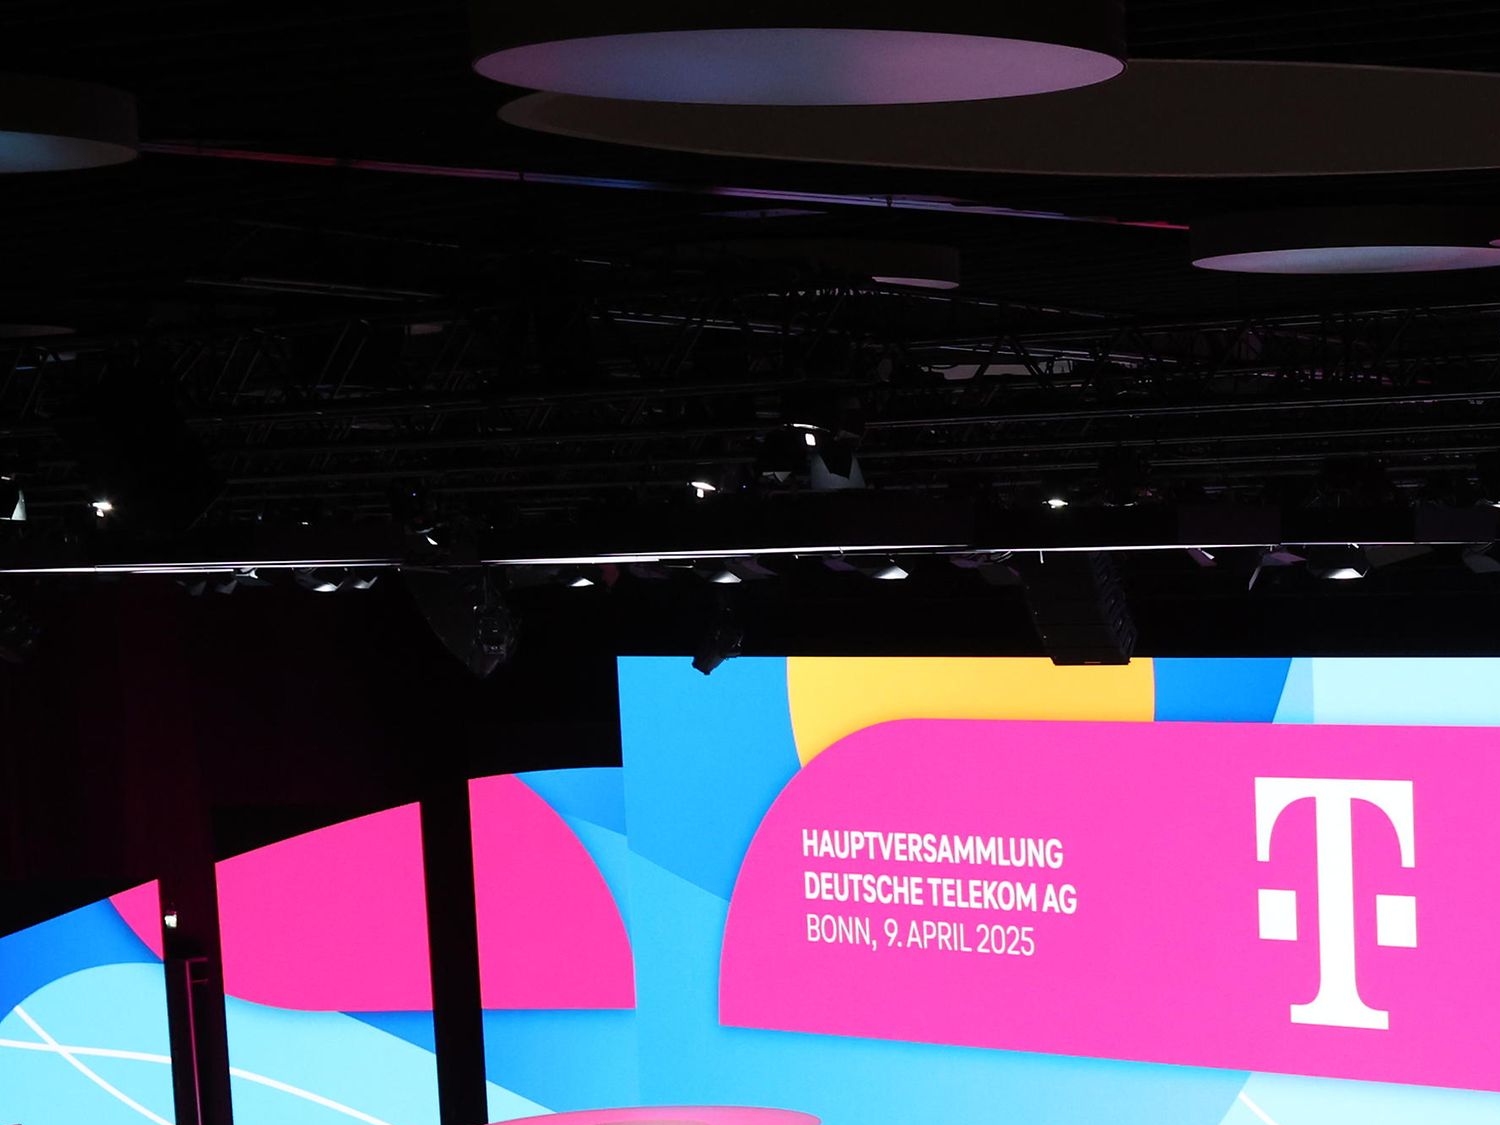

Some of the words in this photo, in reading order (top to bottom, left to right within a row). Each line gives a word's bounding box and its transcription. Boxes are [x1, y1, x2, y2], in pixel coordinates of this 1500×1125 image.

[802, 828, 1064, 870] HAUPTVERSAMMLUNG
[804, 871, 924, 906] DEUTSCHE
[927, 878, 1037, 913] TELEKOM
[1042, 883, 1078, 915] AG
[806, 914, 878, 950] BONN,
[883, 918, 903, 948] 9.
[907, 919, 972, 954] APRIL
[976, 925, 1036, 957] 2025
